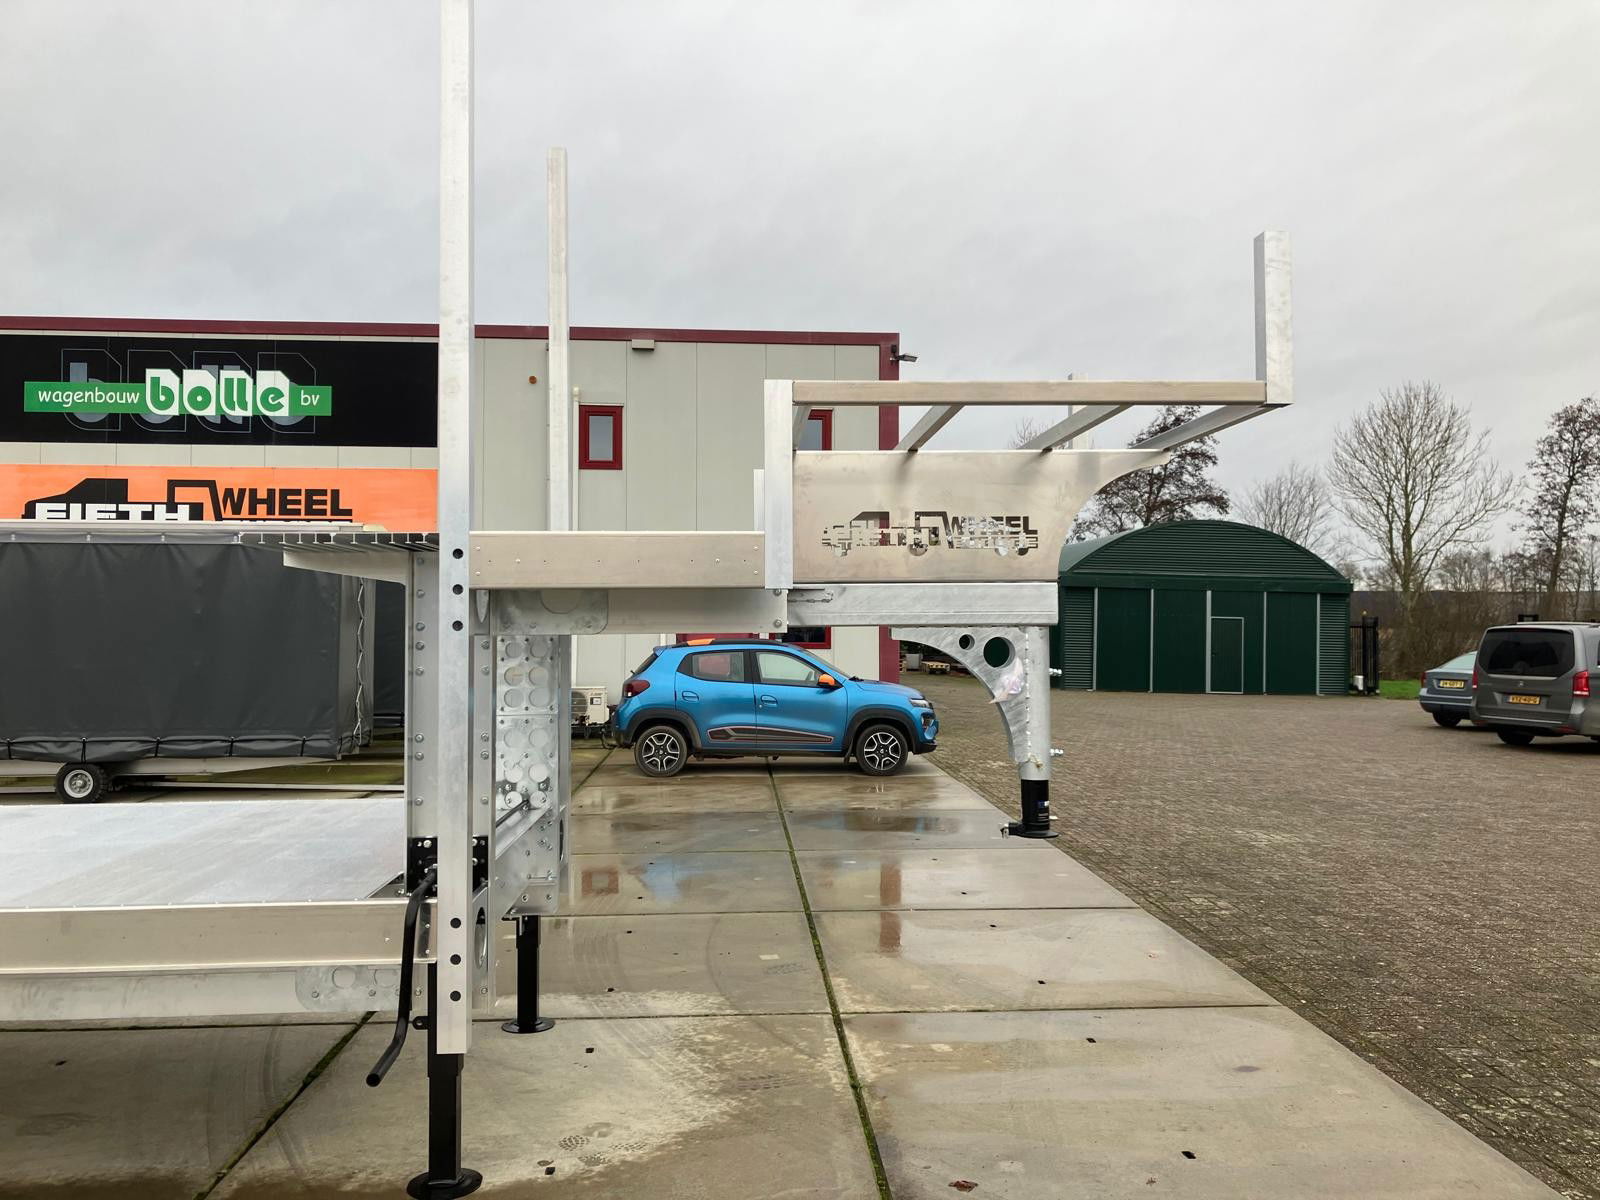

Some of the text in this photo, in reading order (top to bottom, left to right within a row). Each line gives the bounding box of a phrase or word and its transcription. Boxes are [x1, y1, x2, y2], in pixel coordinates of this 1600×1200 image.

[38, 375, 320, 414] wagenbouw bolle bv
[222, 487, 353, 516] WHEEL
